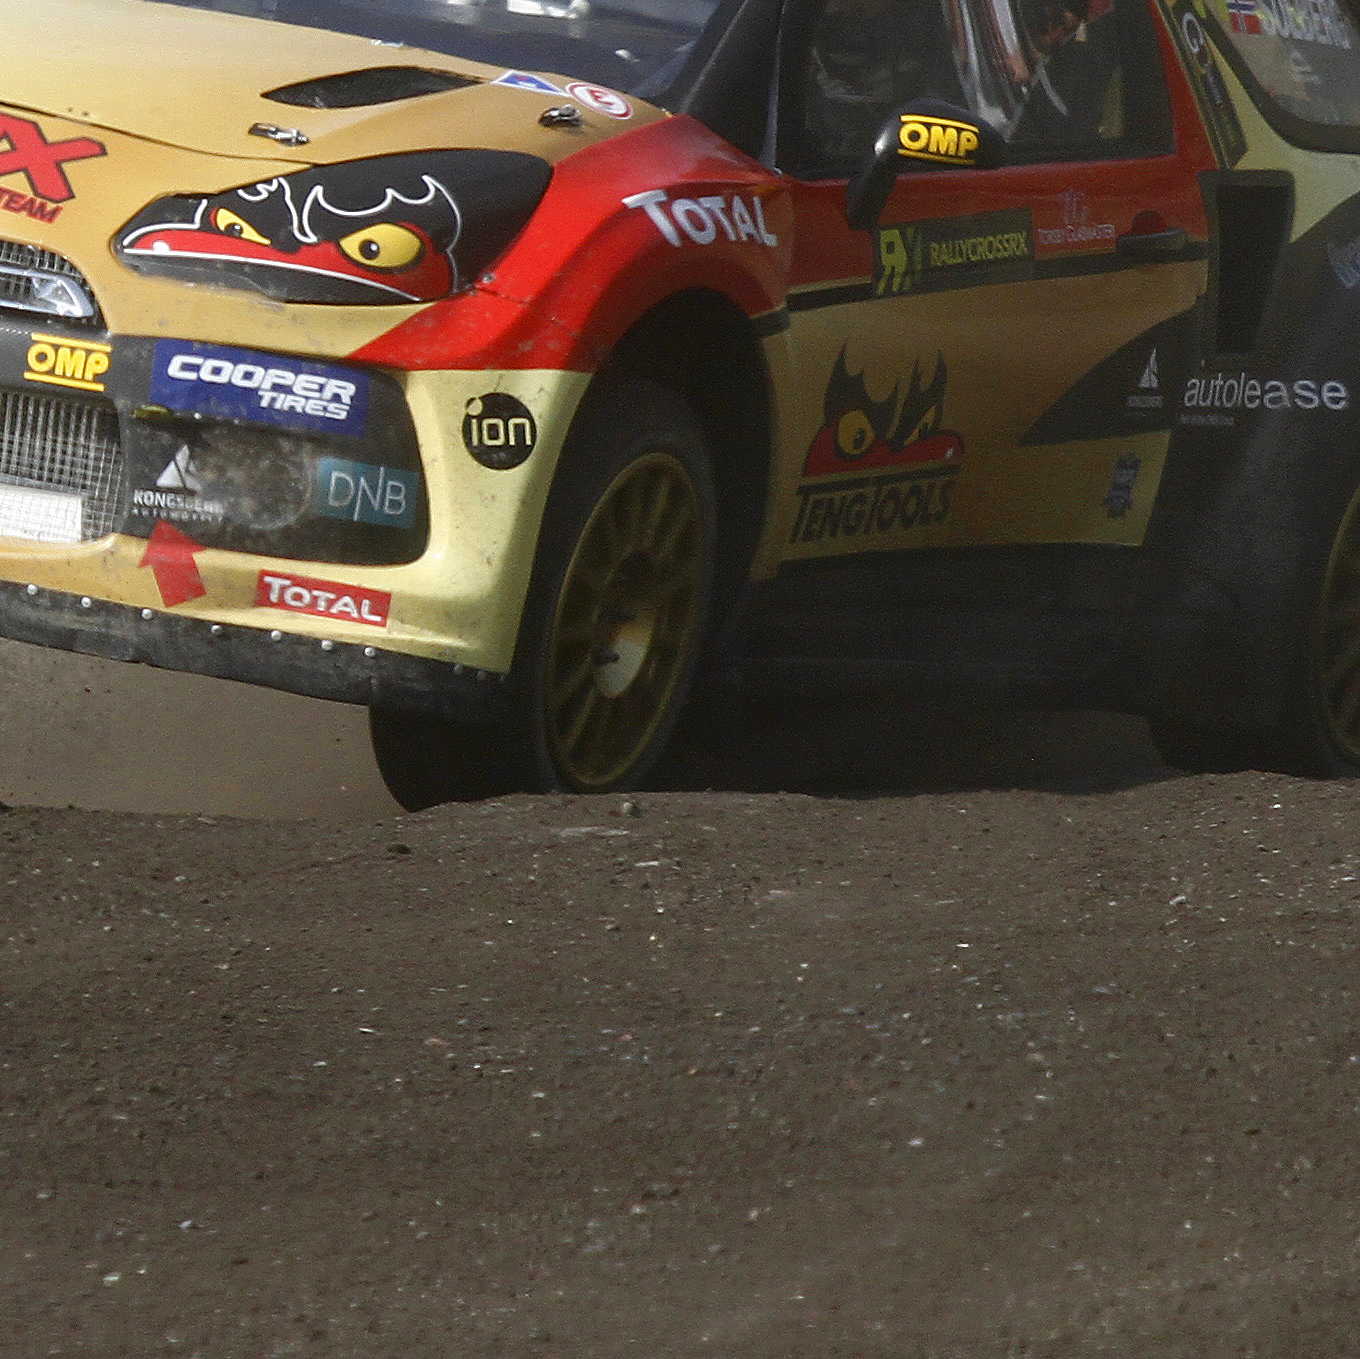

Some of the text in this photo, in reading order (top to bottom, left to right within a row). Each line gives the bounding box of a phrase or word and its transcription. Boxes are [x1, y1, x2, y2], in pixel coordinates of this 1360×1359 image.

[898, 120, 978, 158] OMP
[622, 189, 777, 248] TOTAL
[27, 343, 111, 383] OMP
[167, 353, 356, 406] COOPER
[257, 389, 350, 421] TIRES
[1184, 372, 1348, 410] autolease
[466, 397, 531, 447] ion
[328, 467, 406, 521] DNB
[263, 573, 385, 623] TOTAL
